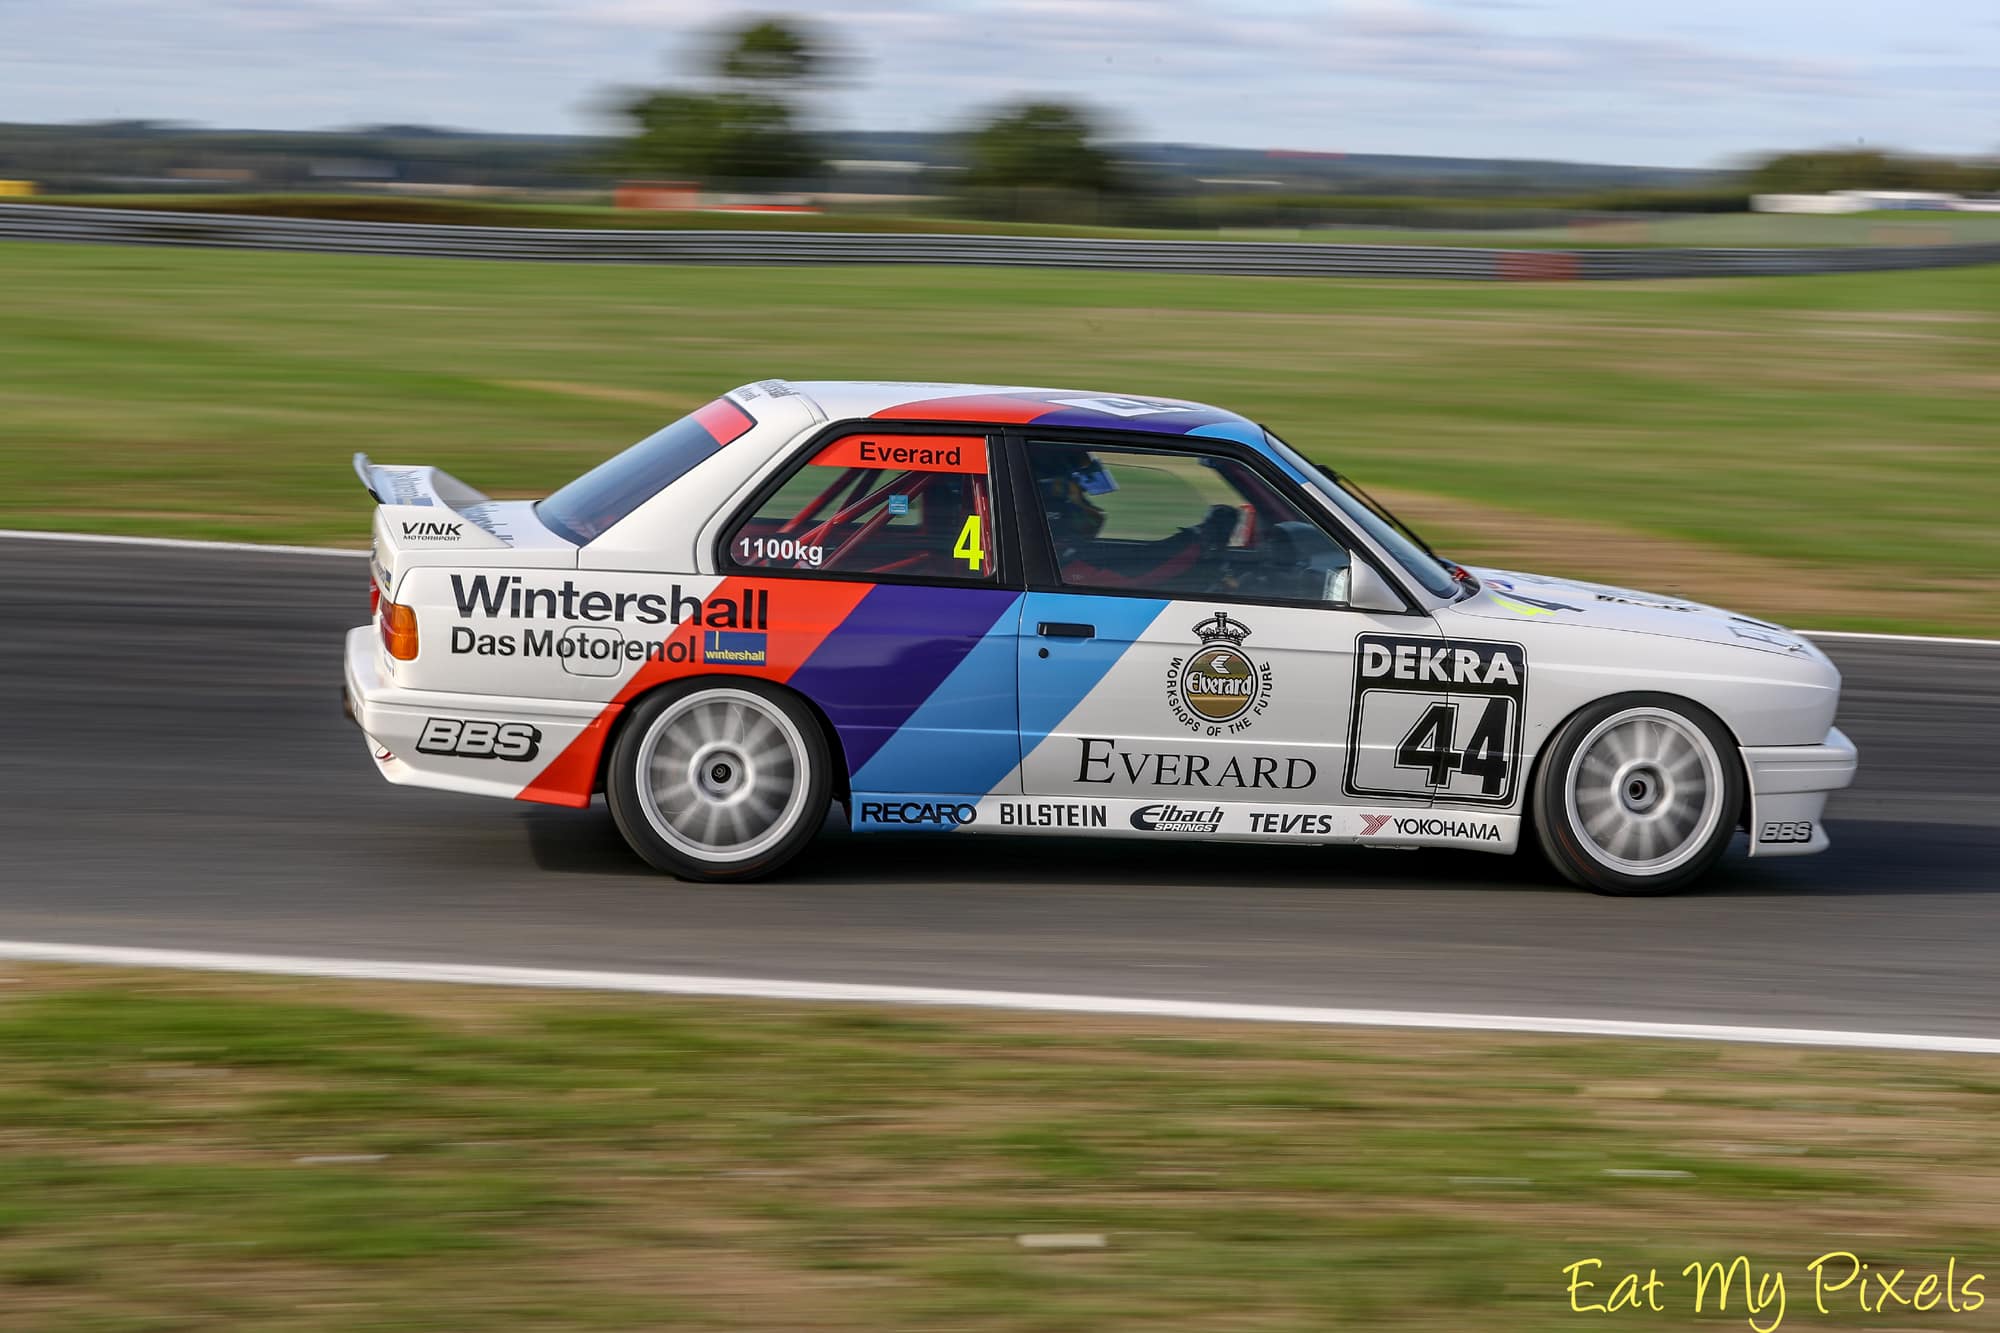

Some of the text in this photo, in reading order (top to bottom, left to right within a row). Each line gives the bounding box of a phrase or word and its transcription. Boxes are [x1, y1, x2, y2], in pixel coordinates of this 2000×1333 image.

[860, 441, 961, 466] Everard
[402, 522, 464, 536] VINK
[739, 537, 823, 566] 1100kg
[953, 515, 985, 571] 4
[450, 574, 768, 629] Wintershall
[451, 626, 696, 663] Das Motorenol
[705, 649, 765, 662] wintershall
[1362, 643, 1519, 685] DEKRA
[1186, 671, 1253, 696] Everard
[1166, 657, 1273, 737] WORKSHOPS OF THE FUTURE
[416, 717, 542, 762] BBS
[1393, 697, 1510, 796] 44
[861, 802, 977, 825] RECARO
[1000, 803, 1107, 828] BILSTEIN
[1130, 804, 1225, 831] Eibach
[1250, 813, 1332, 834] TEVES
[1154, 823, 1214, 832] SPRINGS
[1394, 818, 1501, 841] YOKOHAMA
[1759, 821, 1812, 843] BBS
